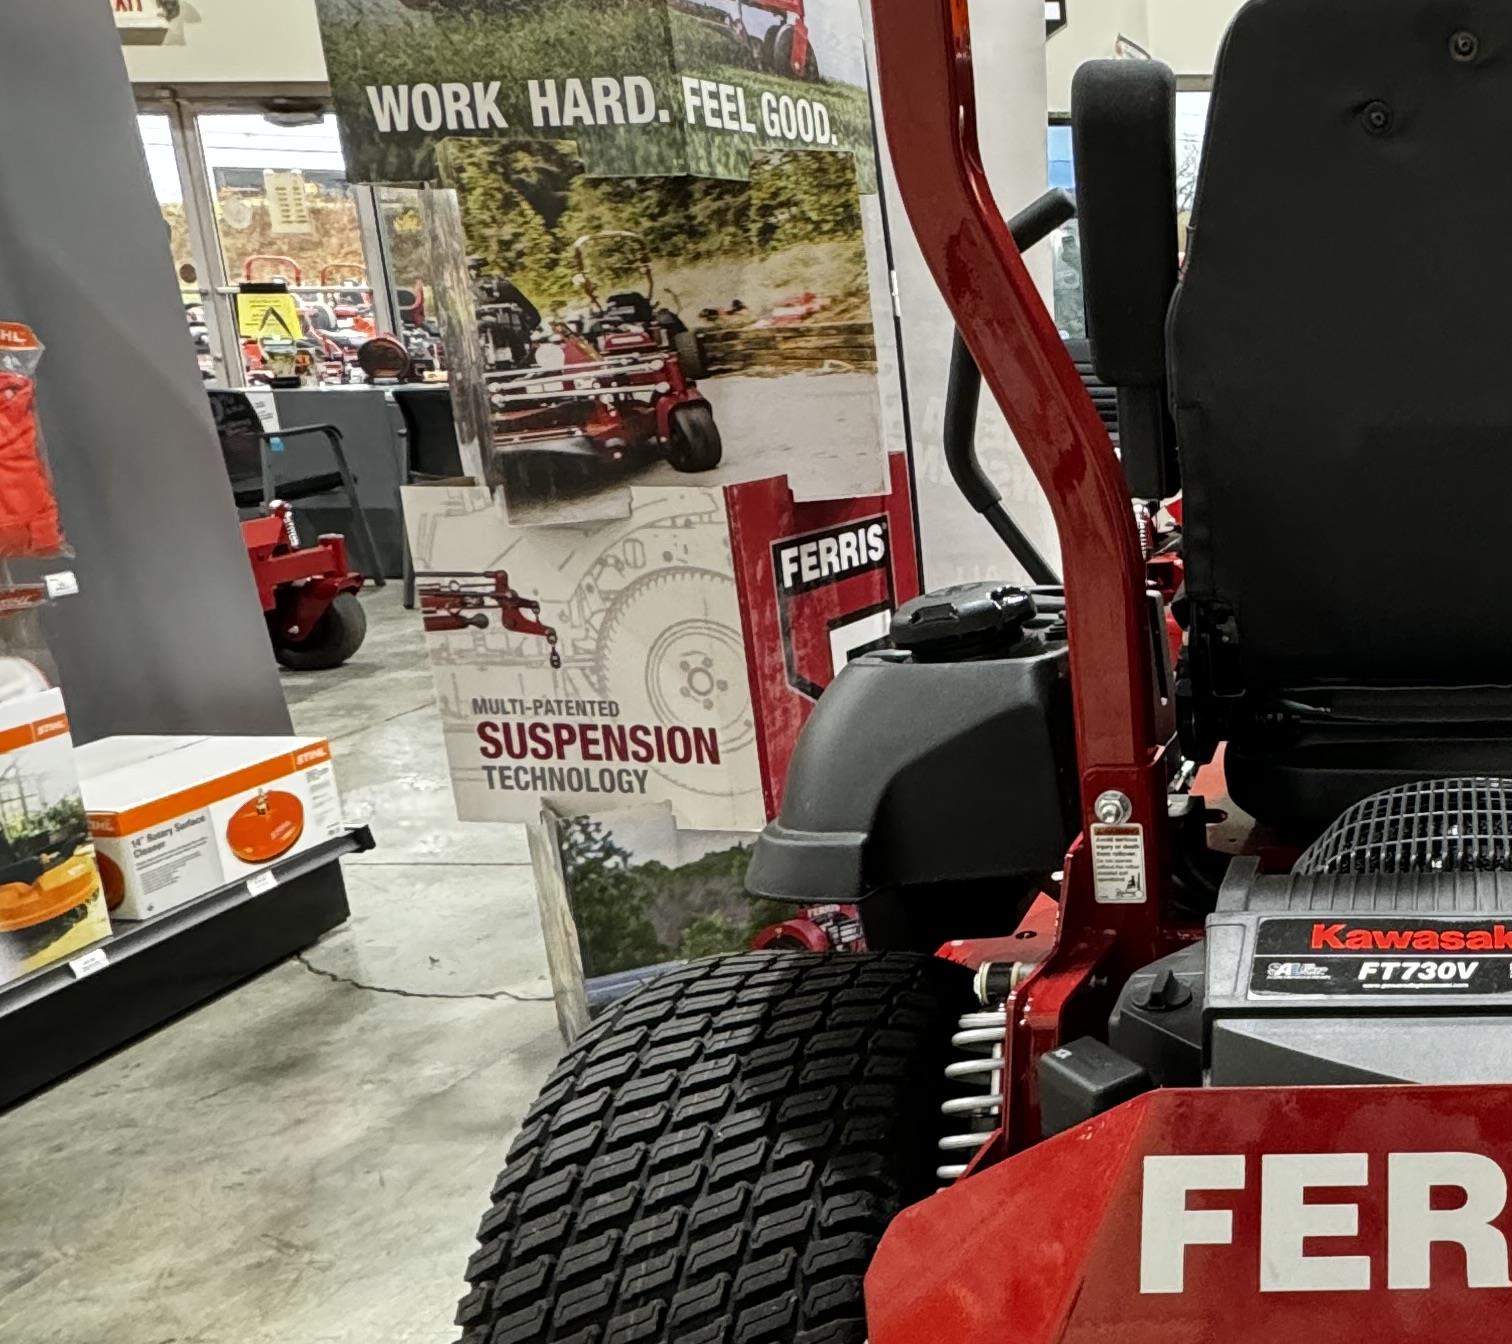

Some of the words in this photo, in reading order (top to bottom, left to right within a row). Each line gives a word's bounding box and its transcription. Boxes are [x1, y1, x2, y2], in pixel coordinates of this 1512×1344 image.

[365, 80, 509, 133] WORK
[527, 75, 670, 128] HARD.
[681, 74, 757, 134] FEEL
[760, 90, 838, 147] GOOD.
[780, 523, 886, 589] FERRIS
[471, 697, 621, 718] MULTI-PATENTED
[476, 721, 721, 765] SUSPENSION
[481, 765, 648, 794] TECHNOLOGY
[174, 815, 206, 833] Surface
[1357, 961, 1479, 980] FT730V
